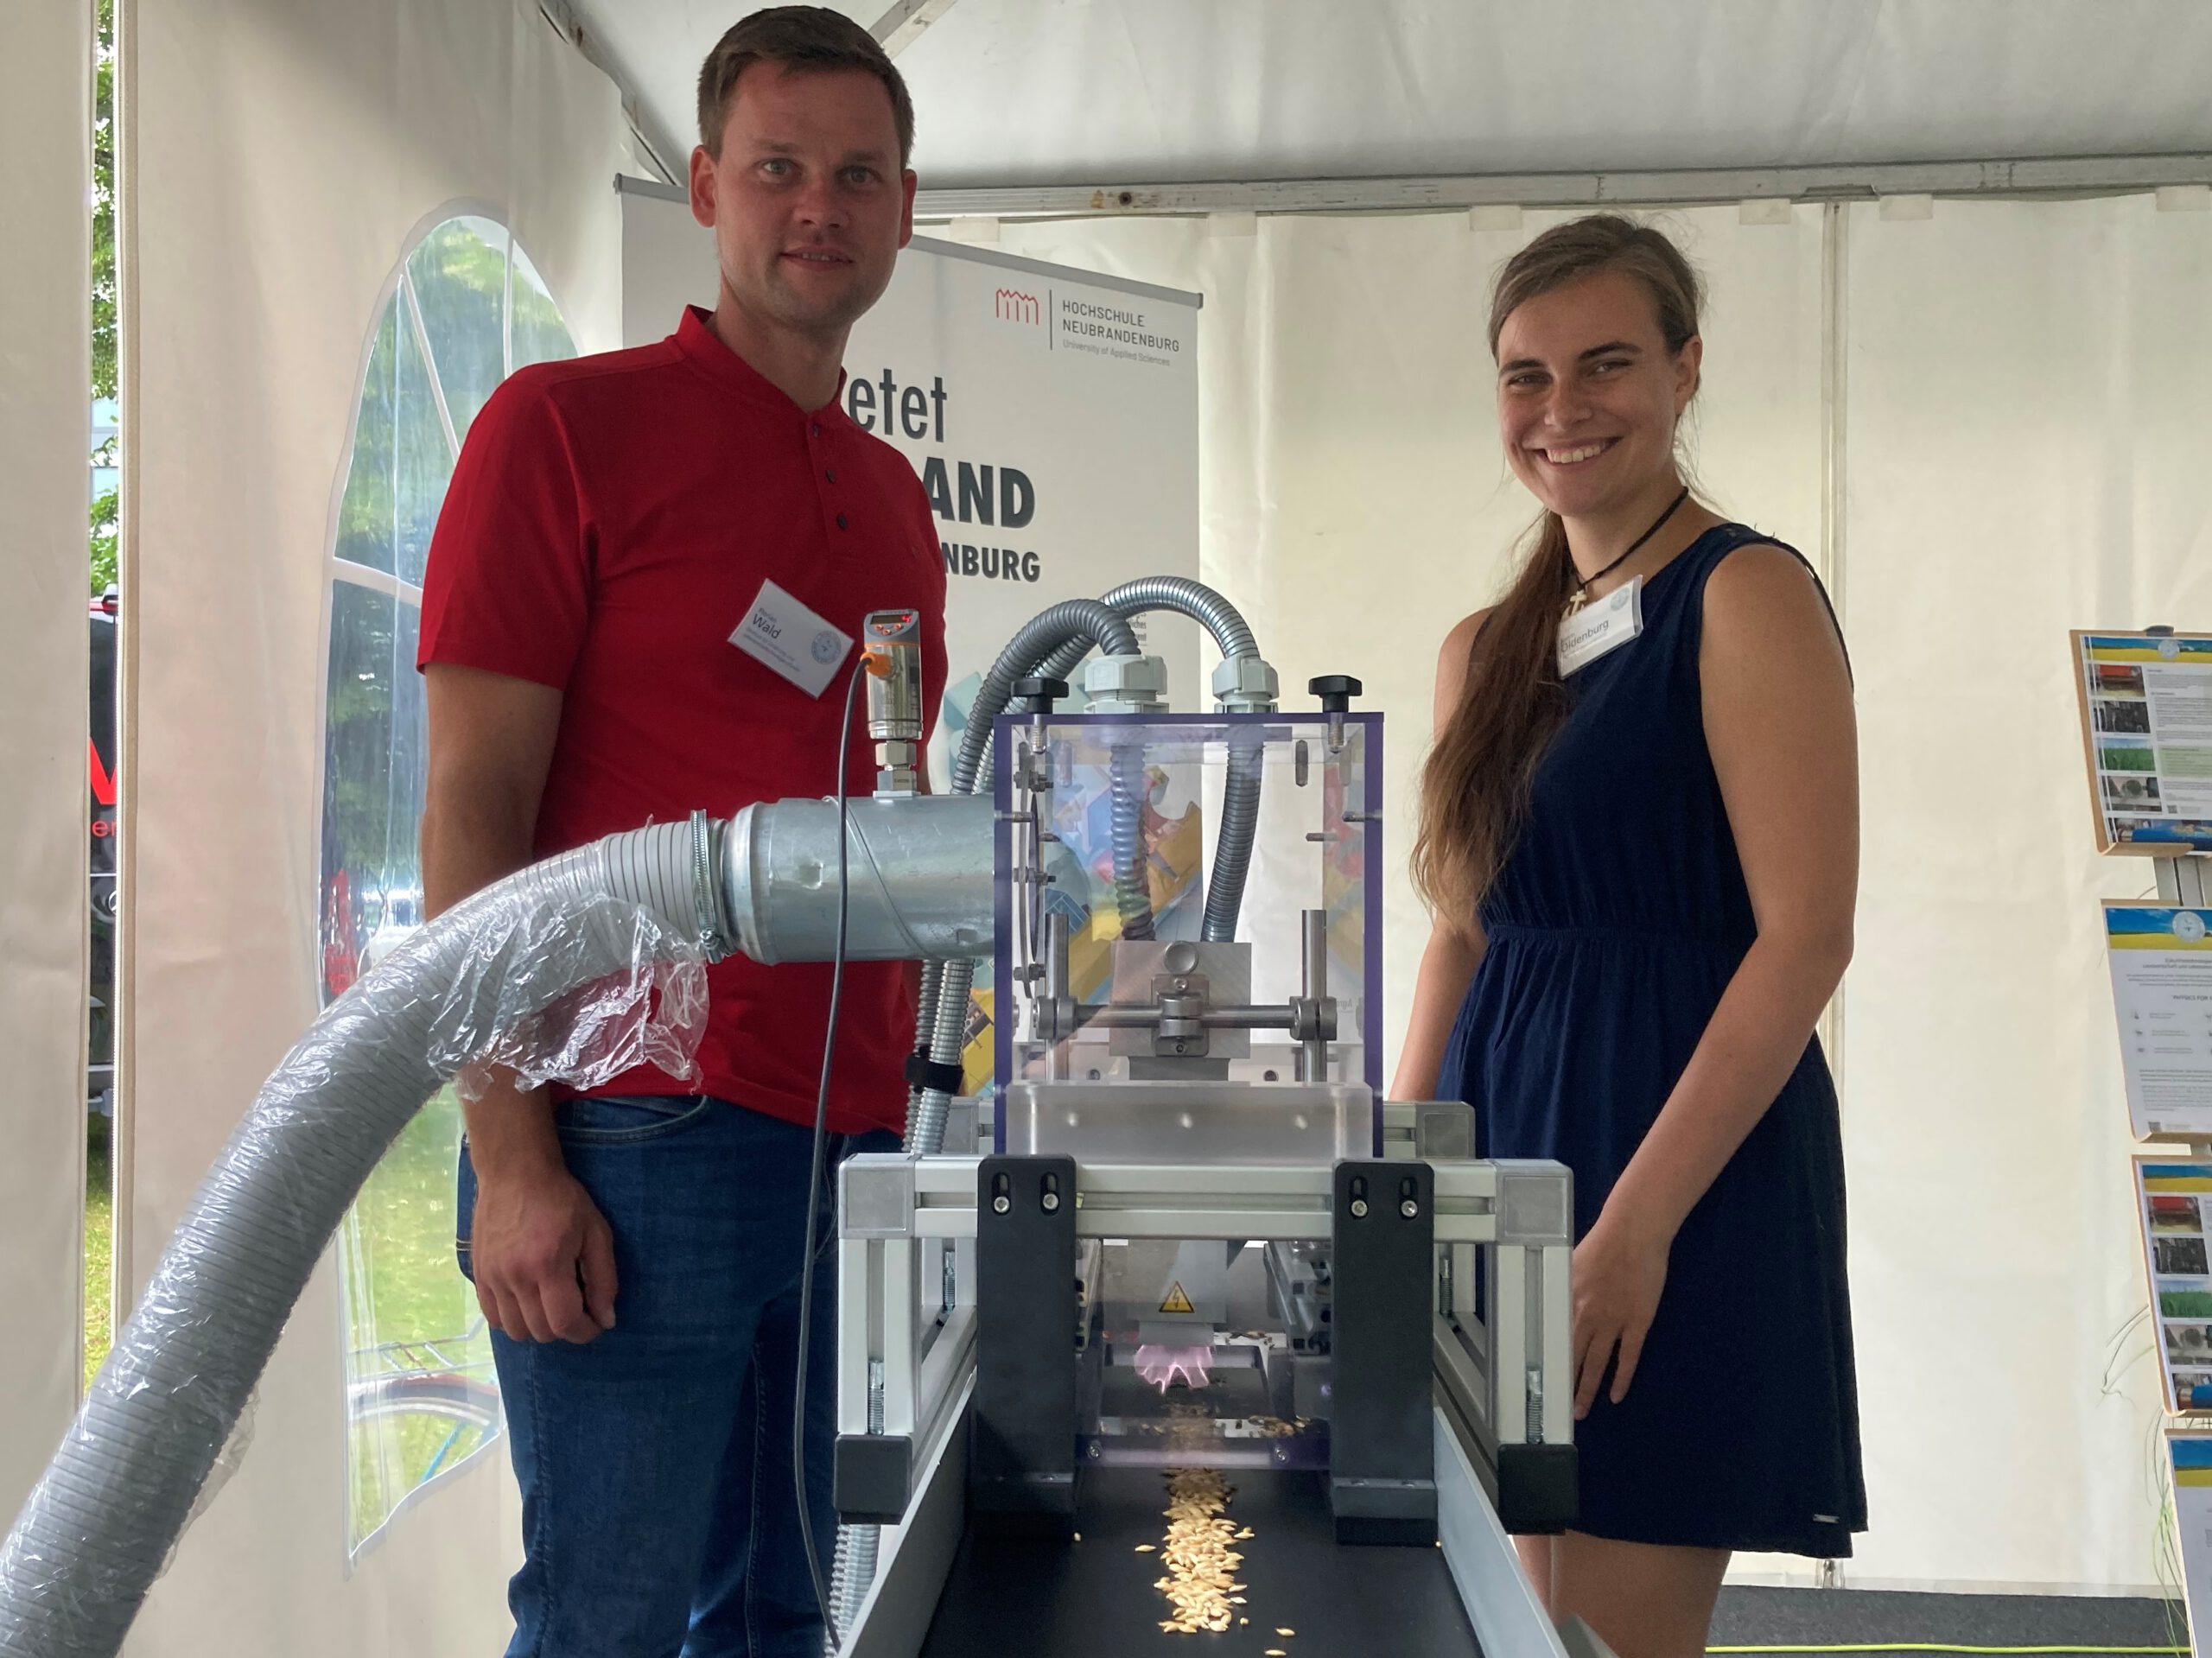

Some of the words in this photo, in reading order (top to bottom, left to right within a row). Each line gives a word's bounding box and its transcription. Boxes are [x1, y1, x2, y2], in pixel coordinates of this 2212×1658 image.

[1062, 300, 1146, 327] HOCHSCHULE
[1062, 319, 1180, 353] NEUBRANDENBURG
[1063, 339, 1100, 356] University
[1101, 346, 1109, 356] of
[1109, 348, 1137, 361] Applied
[1138, 353, 1171, 366] Sciences
[753, 613, 782, 639] Wald
